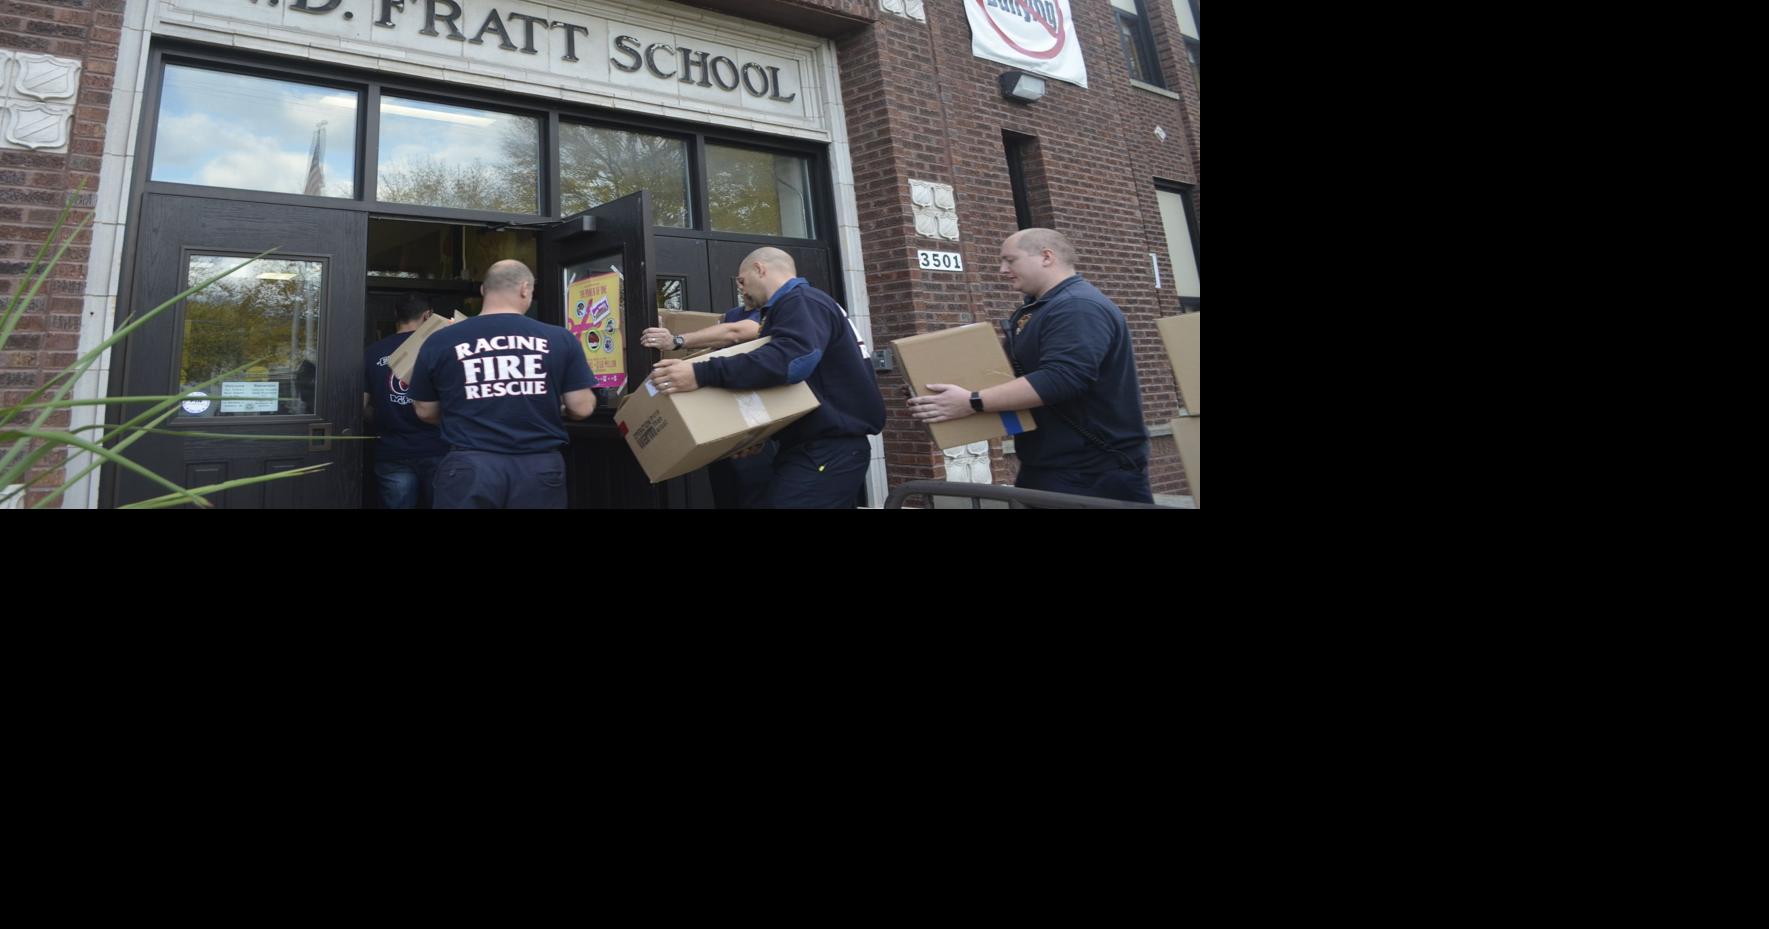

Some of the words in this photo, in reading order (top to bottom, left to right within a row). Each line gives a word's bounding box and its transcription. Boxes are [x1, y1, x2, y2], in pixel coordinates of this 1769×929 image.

[374, 0, 589, 62] FRATT
[610, 35, 796, 103] SCHOOL
[920, 252, 961, 269] 3501
[454, 335, 550, 360] RACINE
[462, 354, 548, 384] FIRE
[464, 381, 548, 400] RESCUE
